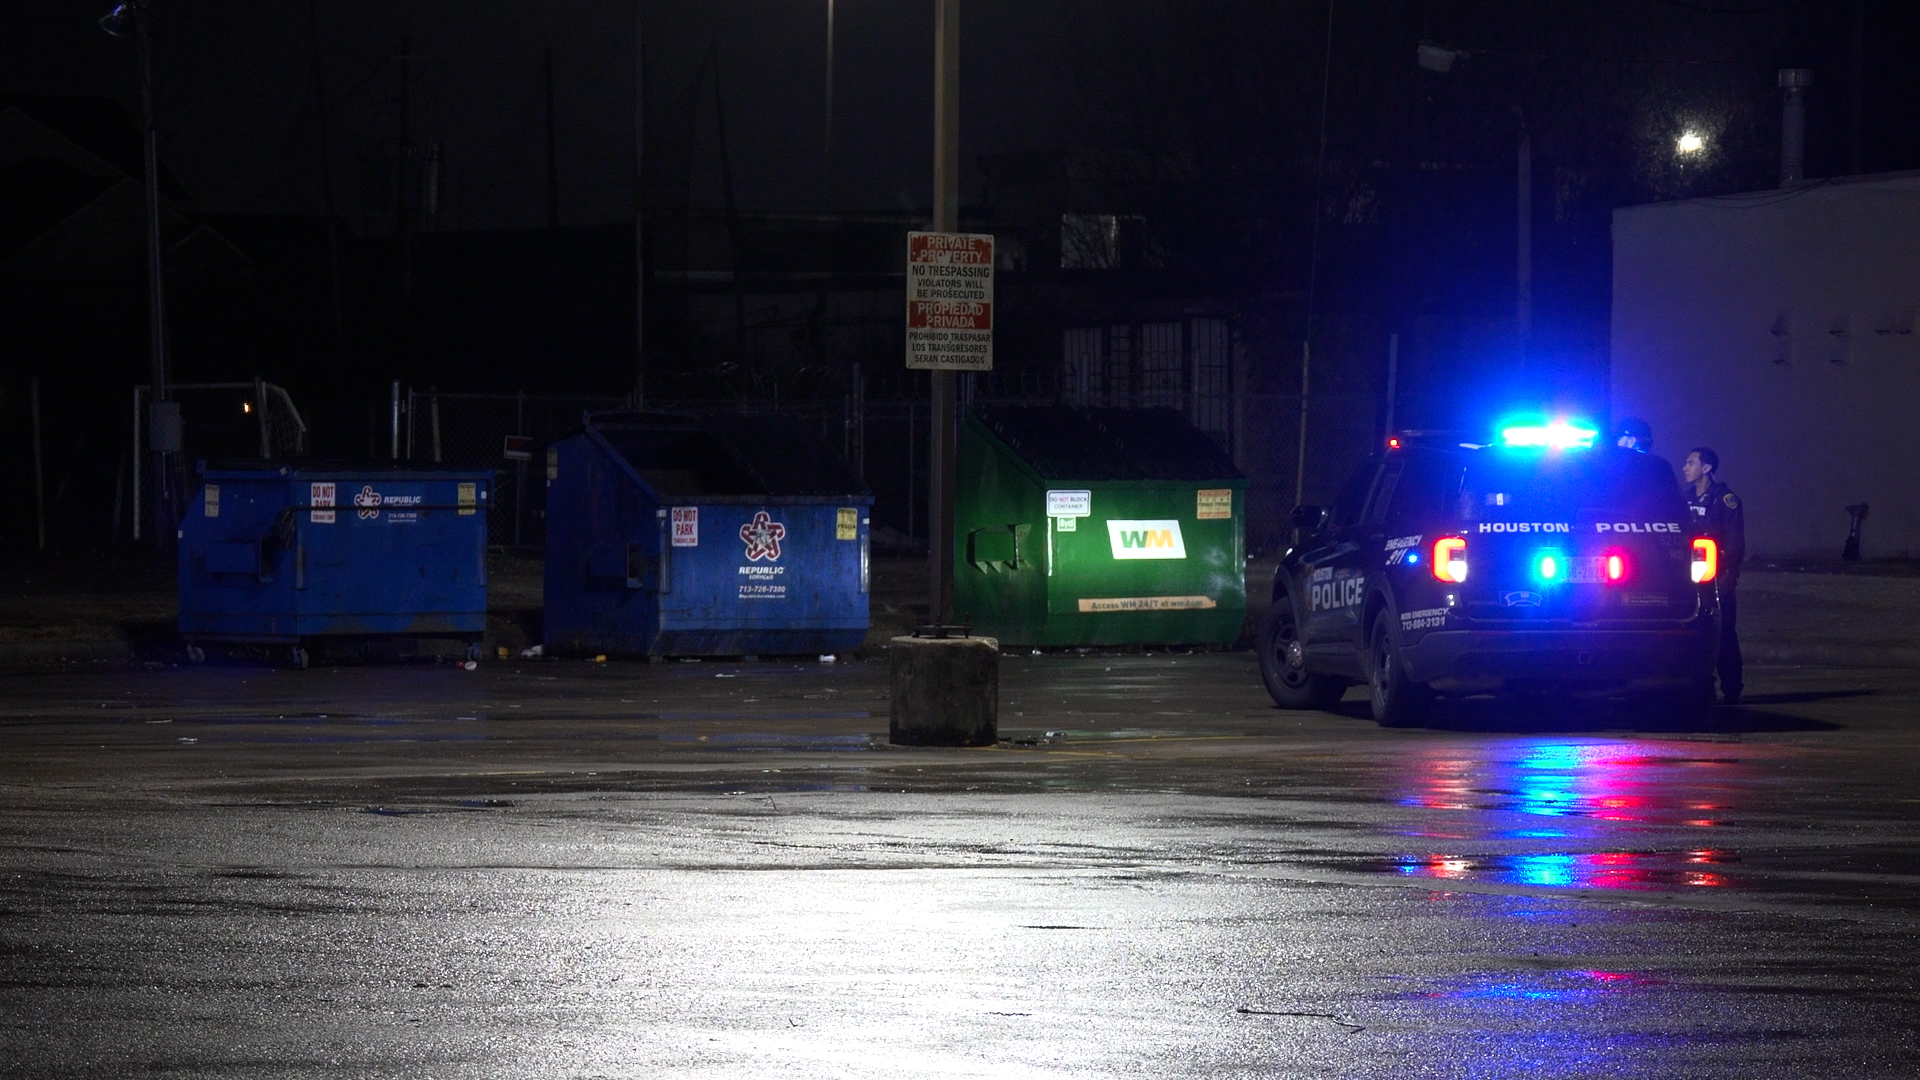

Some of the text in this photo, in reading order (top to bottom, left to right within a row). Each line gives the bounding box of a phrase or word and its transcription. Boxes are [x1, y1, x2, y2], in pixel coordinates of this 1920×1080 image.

[927, 236, 976, 250] PRIVATE
[920, 249, 983, 263] PROERTY
[912, 265, 990, 278] NO TRESPASSING
[917, 278, 985, 289] VIOLATORS WILL
[917, 289, 985, 300] BE PROSECUTED
[918, 302, 984, 316] PROPIEDAD
[926, 315, 976, 328] PRIVADA
[909, 331, 991, 342] PROHIBIDO TRASPASAR
[912, 343, 988, 354] LOS TRANSGRESORES
[914, 354, 985, 364] SERAN CASTIGADOS
[313, 485, 334, 498] DO NOT
[384, 496, 421, 504] REPUBLIC
[673, 510, 697, 522] DO NOT
[675, 523, 694, 535] PARK
[1479, 522, 1682, 533] HOUSTON POLICE
[1120, 530, 1174, 548] WM
[1384, 534, 1423, 551] EMERGENCY
[1385, 548, 1408, 566] 911
[738, 566, 785, 575] REPUBLIC
[739, 585, 786, 593] 713-726-7300
[1312, 576, 1365, 611] POLICE
[1091, 600, 1205, 610] Access WM 24/7 at wm.com
[1412, 607, 1449, 619] EMERGENCY
